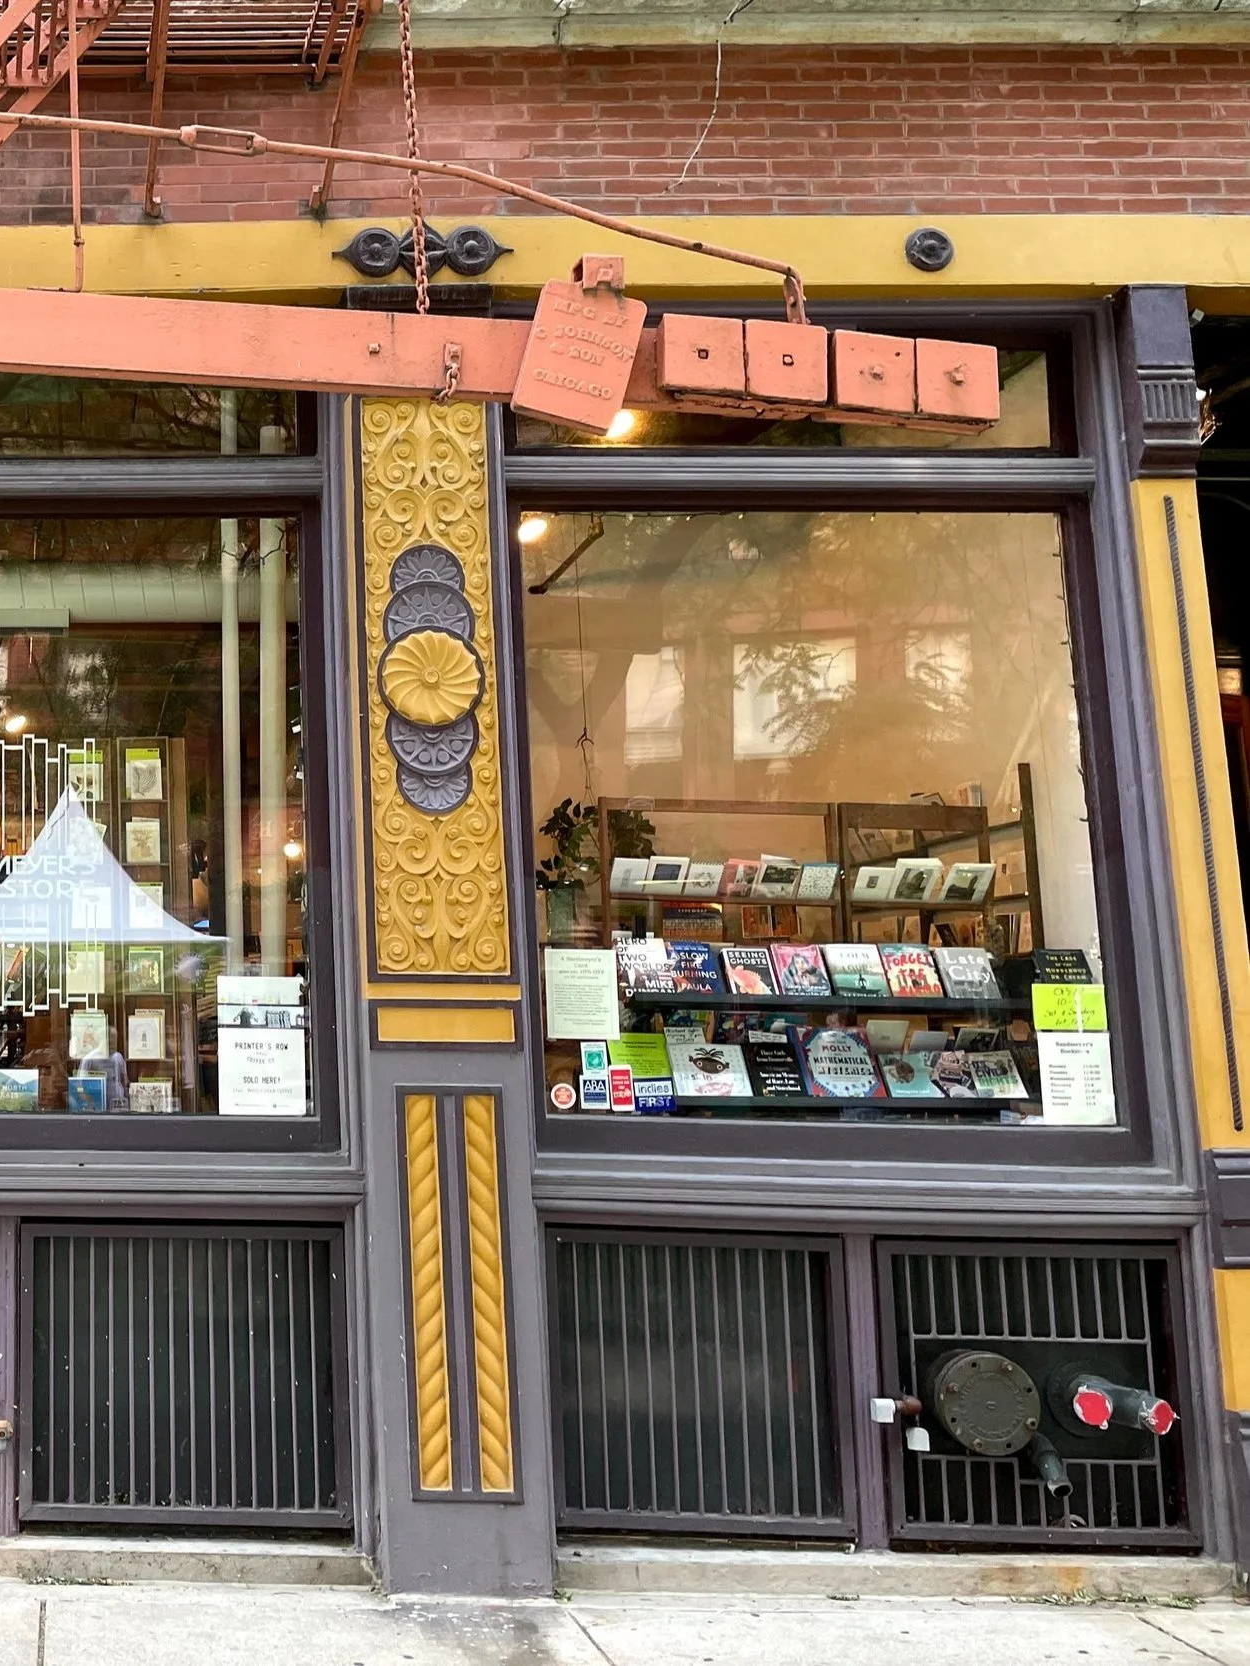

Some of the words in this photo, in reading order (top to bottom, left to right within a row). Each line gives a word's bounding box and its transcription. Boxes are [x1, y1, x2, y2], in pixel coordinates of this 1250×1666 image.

[553, 324, 634, 363] JOHNSON
[568, 345, 605, 366] SON
[533, 367, 613, 400] CHICAGO
[616, 938, 647, 946] HERO
[619, 953, 647, 962] TWO
[680, 952, 709, 960] SLOW
[943, 950, 985, 964] Late
[681, 961, 703, 970] FIRE
[884, 953, 931, 970] FORGET
[619, 962, 670, 971] WORLDS
[671, 970, 717, 979] BURNING
[948, 966, 991, 984] City
[645, 980, 675, 989] MIKE
[681, 982, 712, 991] PAULA
[234, 1042, 272, 1051] PRINTER'S
[275, 1043, 289, 1051] ROW
[821, 1044, 852, 1053] MOLLY
[813, 1056, 869, 1065] MATHEMATICAL
[243, 1076, 259, 1084] SOLD
[584, 1080, 606, 1090] ABA
[638, 1083, 670, 1094] indies
[638, 1096, 671, 1108] FIRST
